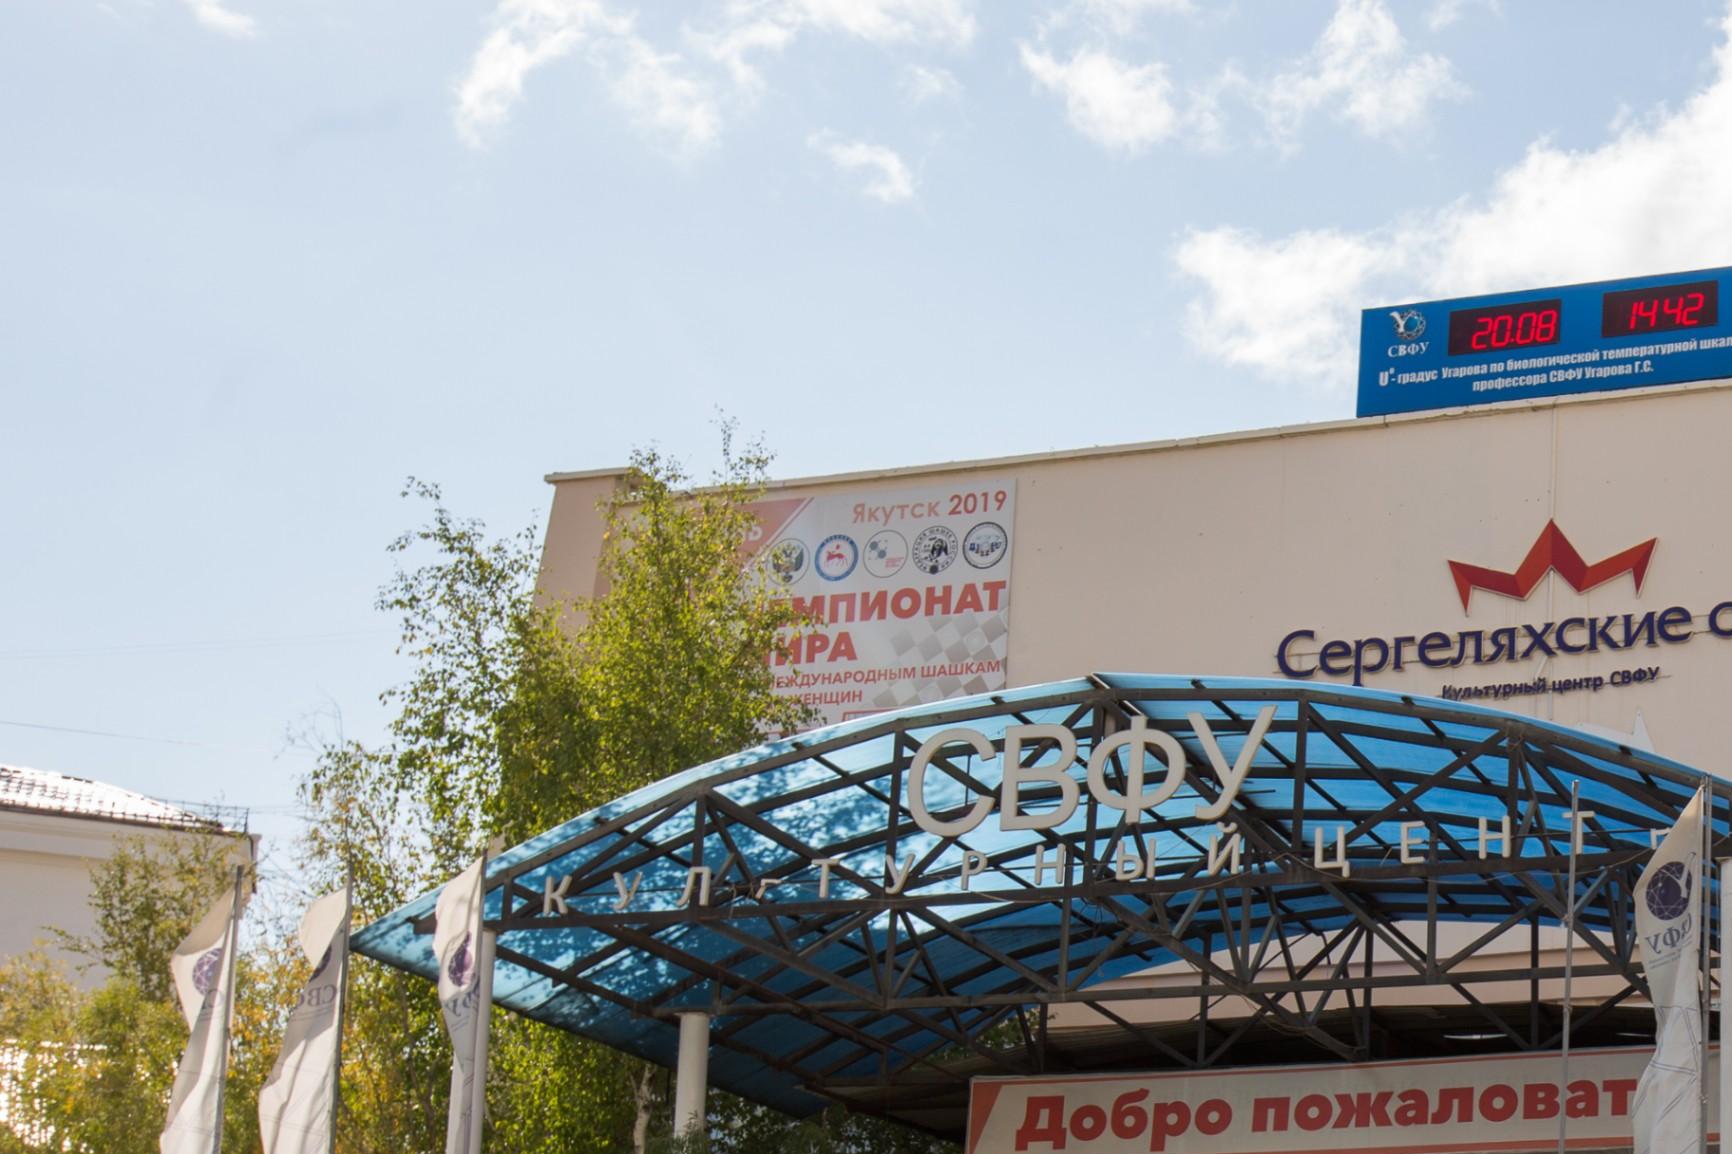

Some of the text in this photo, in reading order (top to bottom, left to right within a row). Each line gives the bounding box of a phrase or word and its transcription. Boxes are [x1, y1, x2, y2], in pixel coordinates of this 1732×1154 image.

[1387, 341, 1430, 358] СВФУ
[1441, 363, 1488, 379] Угарова
[1490, 362, 1504, 373] по
[1506, 349, 1600, 372] биологической
[1602, 338, 1698, 361] температурной
[1472, 359, 1655, 392] профессора СВФУ Угарова Г.С.
[852, 490, 1008, 525] Якутск 2019
[772, 580, 1007, 628] МПИОНАТ
[1275, 604, 1692, 687] Сергеляхские
[921, 660, 1001, 678] ШАШКАМ
[1441, 665, 1661, 701] Культурный центр СВФУ
[908, 705, 1278, 838] СВФУ
[1013, 1078, 1638, 1152] Добро пожаловат
